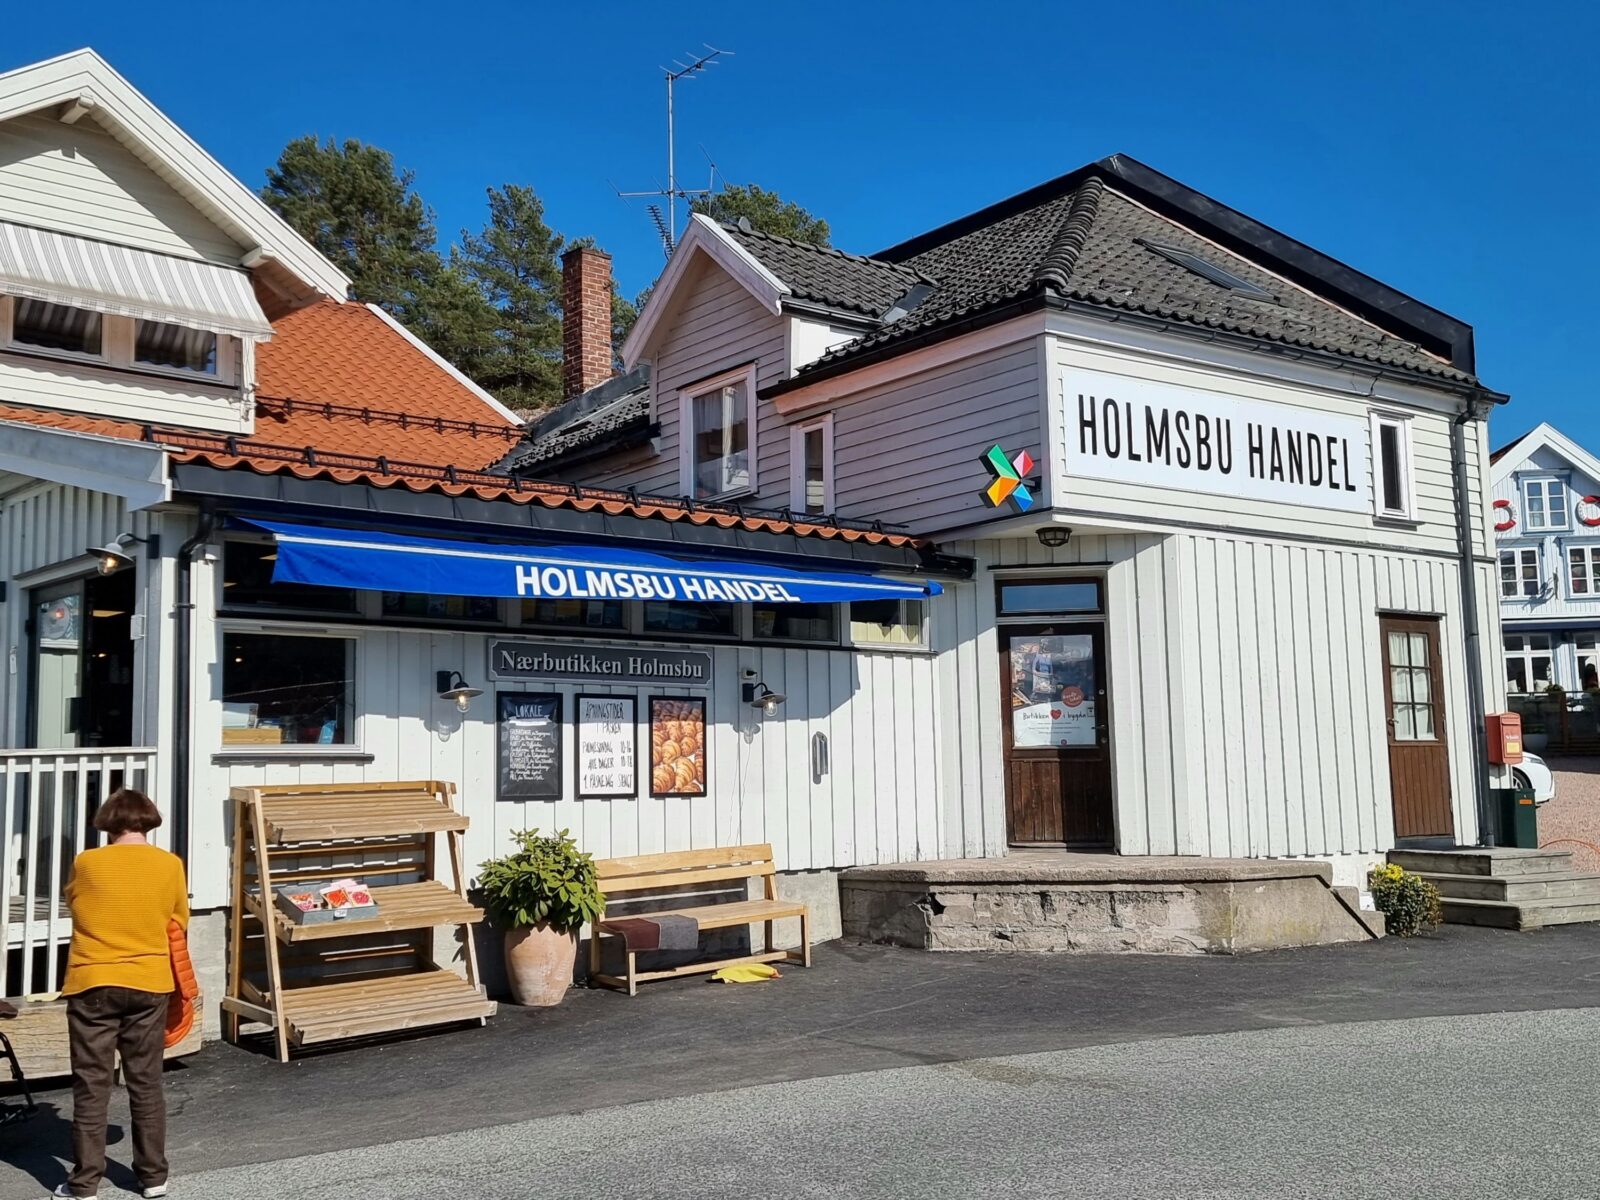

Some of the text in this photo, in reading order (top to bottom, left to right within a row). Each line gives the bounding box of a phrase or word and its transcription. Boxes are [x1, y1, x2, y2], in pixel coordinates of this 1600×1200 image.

[1078, 394, 1357, 492] HOLMSBU HANDEL
[515, 565, 801, 602] HOLMSBU HANDEL
[500, 650, 703, 678] Nærbutikken Holmsbu
